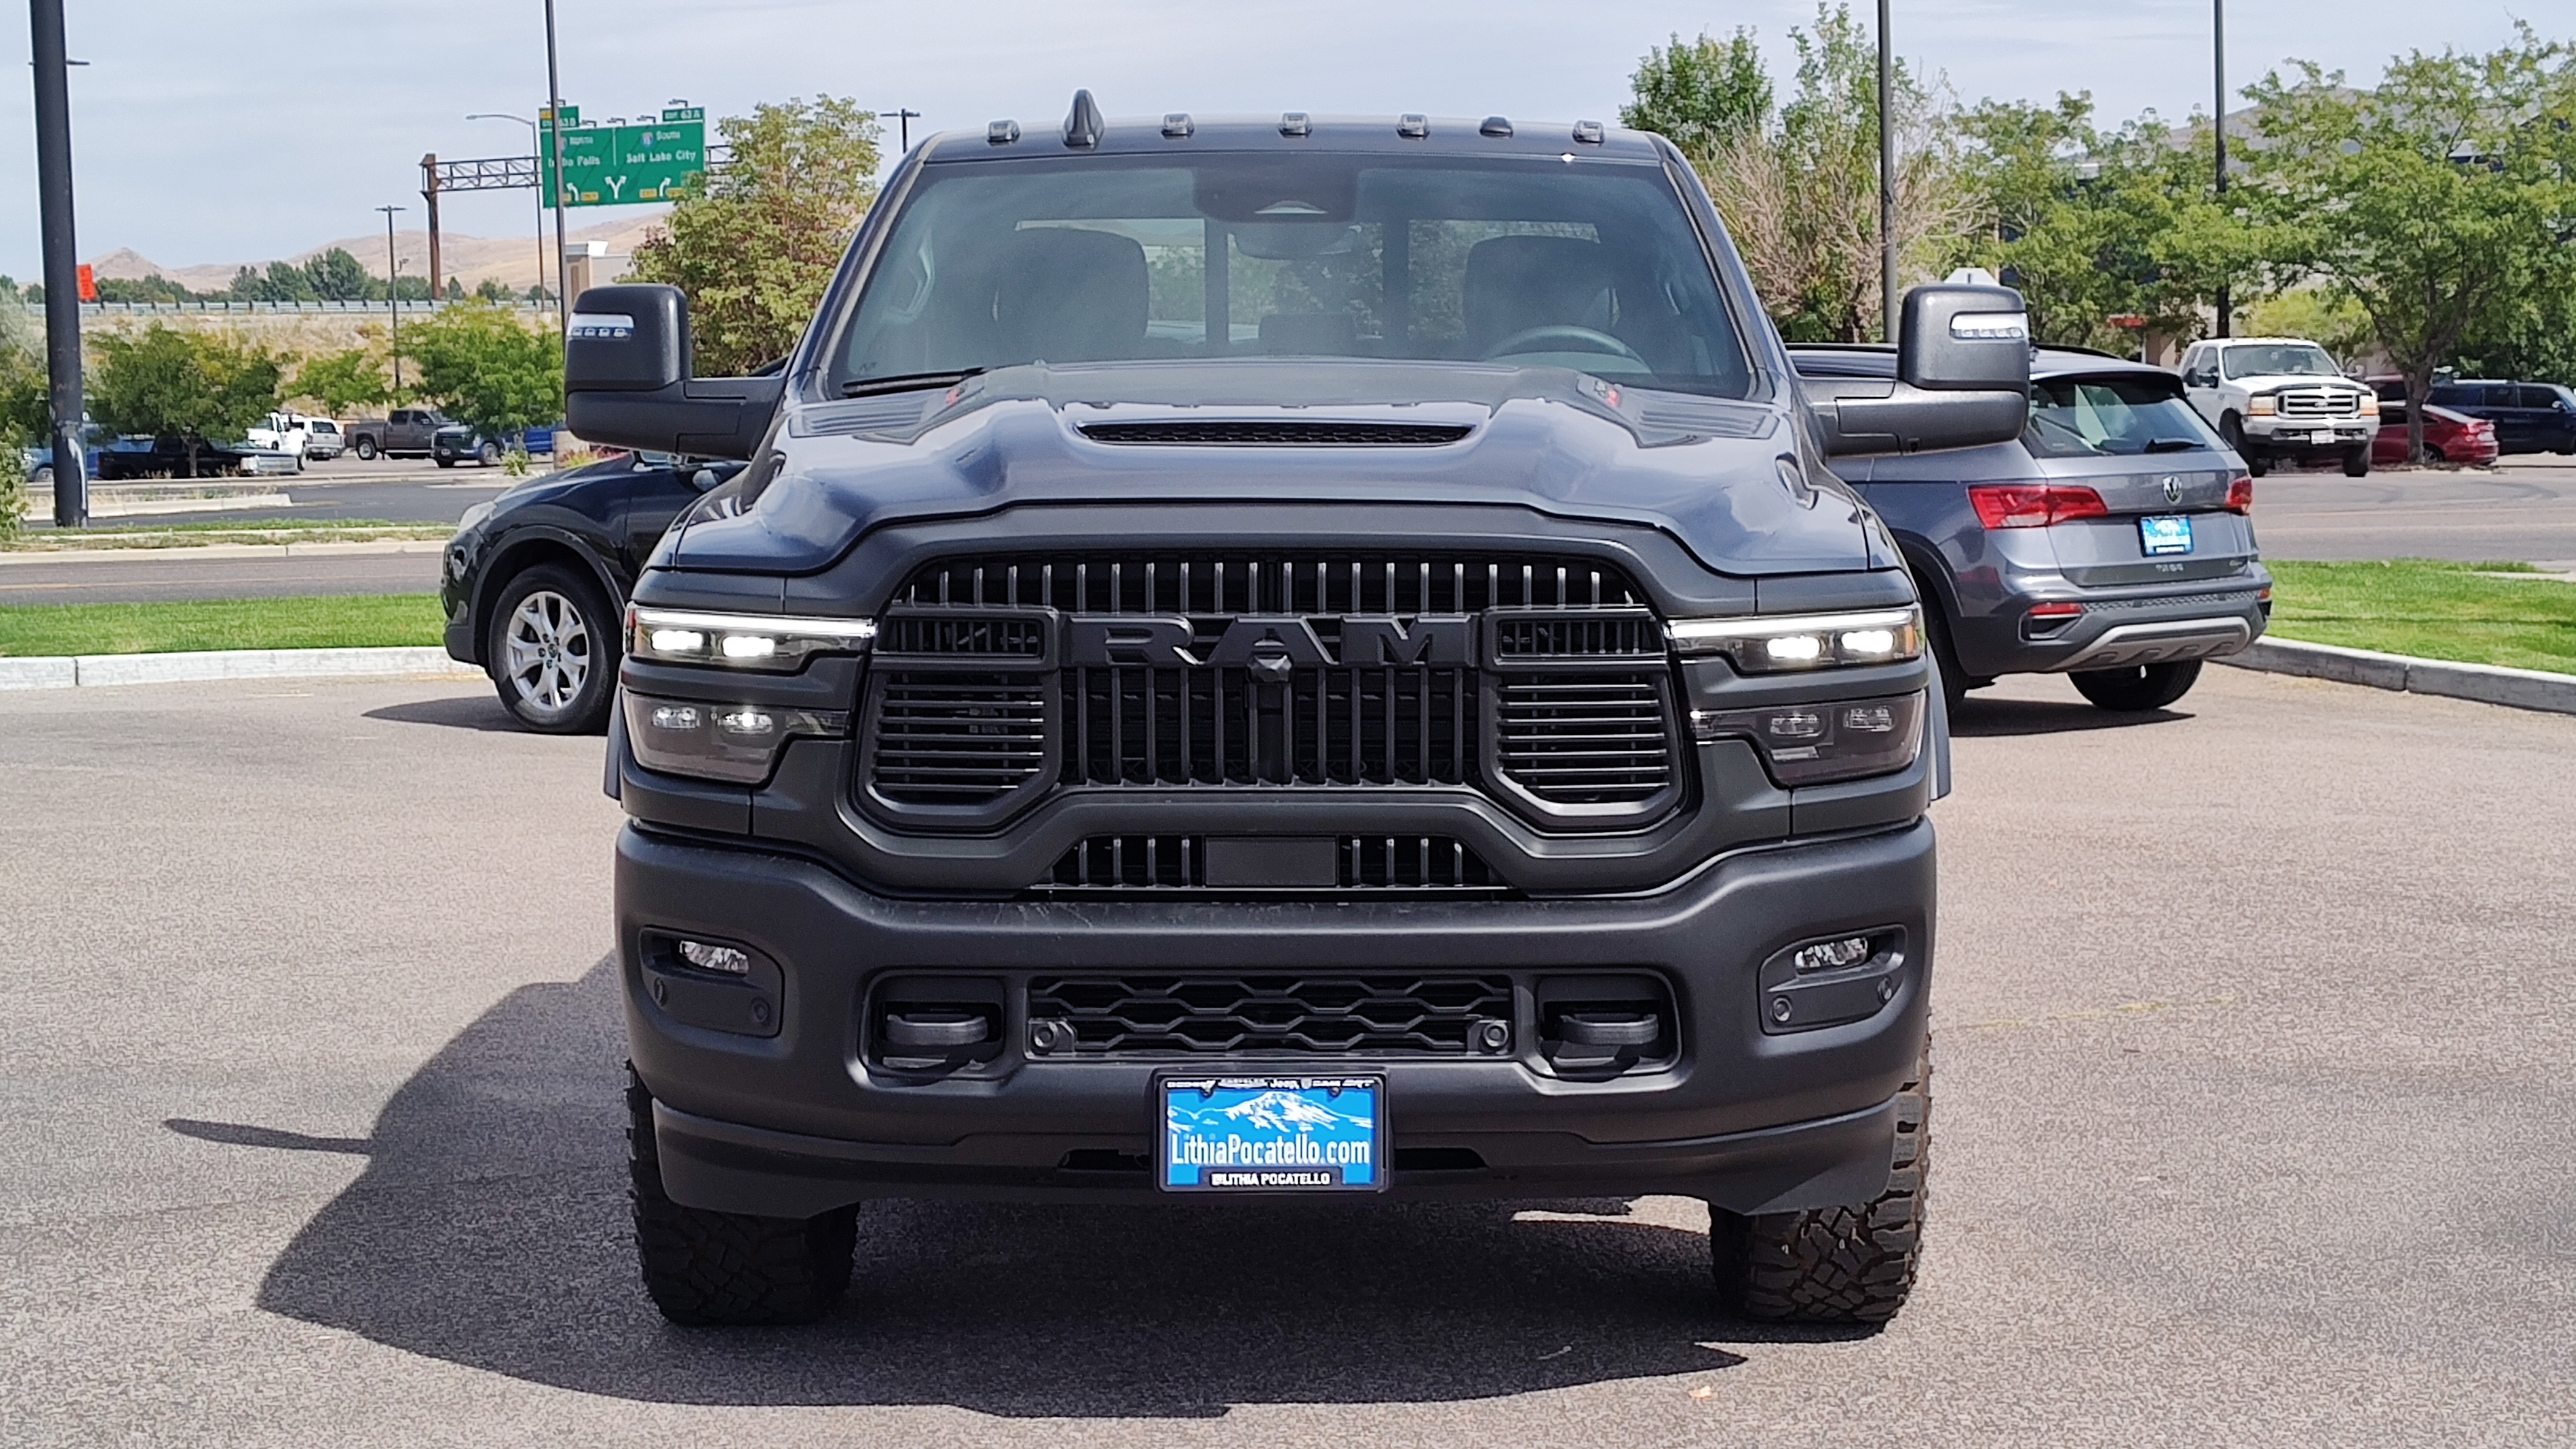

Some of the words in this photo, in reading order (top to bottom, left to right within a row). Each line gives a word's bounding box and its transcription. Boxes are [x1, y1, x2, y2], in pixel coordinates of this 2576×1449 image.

[577, 155, 600, 166] Falls
[626, 153, 645, 163] Salt
[649, 152, 672, 162] Lake
[675, 150, 696, 162] City
[1070, 616, 1470, 667] RAM
[1172, 1133, 1370, 1165] LithiaPocatello.com
[1260, 1173, 1330, 1185] POCATELLO
